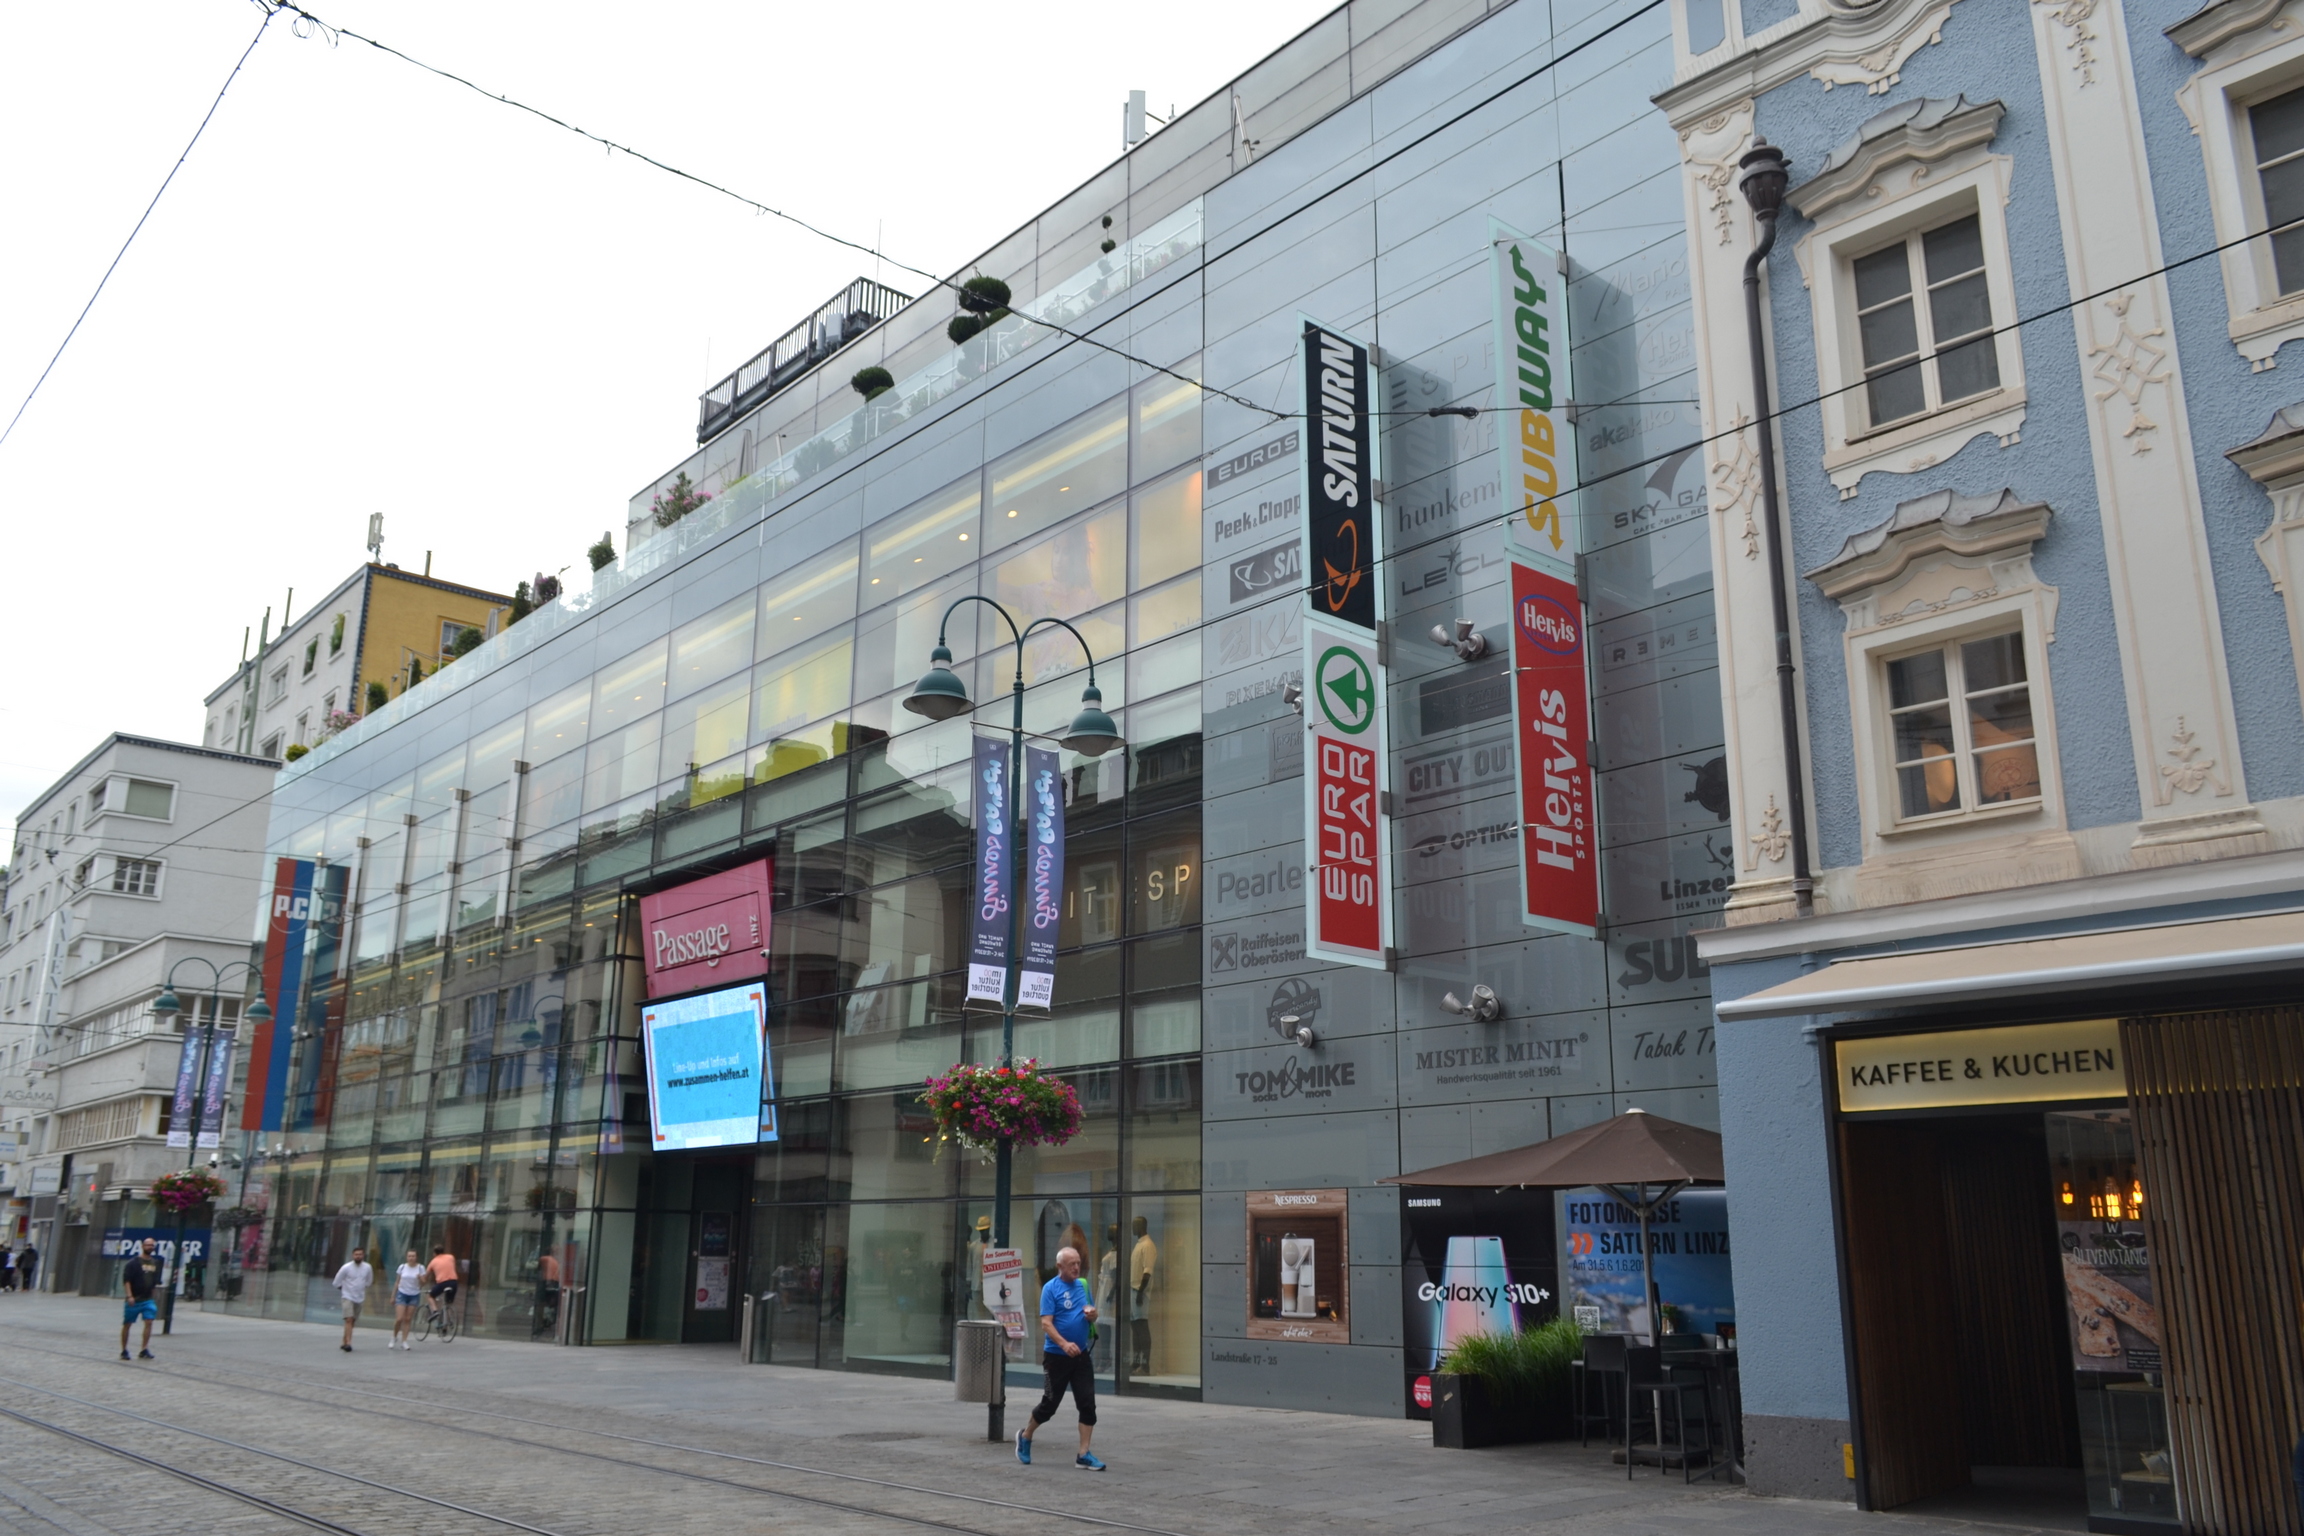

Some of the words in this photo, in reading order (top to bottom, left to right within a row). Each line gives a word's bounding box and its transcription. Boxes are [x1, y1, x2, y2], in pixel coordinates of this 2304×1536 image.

[1508, 244, 1564, 552] SUBWAY
[1320, 331, 1358, 508] SATURN
[1218, 433, 1297, 481] EUROS
[1399, 472, 1501, 532] hunkem
[1614, 500, 1661, 529] SKY
[1523, 602, 1576, 643] Hervis
[1408, 755, 1463, 793] CITY
[1533, 688, 1577, 872] Hervis
[1323, 744, 1347, 901] EURO
[1350, 751, 1373, 907] SPAR
[1572, 775, 1585, 860] SPORTS
[1217, 861, 1301, 904] Pearle
[749, 914, 760, 945] LINZ
[1241, 932, 1299, 951] Raiffeisen
[653, 923, 730, 968] Passage
[1416, 1046, 1500, 1070] MISTER
[1634, 1029, 1688, 1060] Tabak
[1518, 1068, 1535, 1079] seit
[1537, 1066, 1563, 1077] 1961
[1851, 1060, 1954, 1087] KAFFEE
[1963, 1058, 1983, 1079] &
[1993, 1048, 2115, 1078] KUCHEN
[1305, 1089, 1332, 1098] more
[1274, 1194, 1317, 1206] NESPRESSO
[1408, 1199, 1441, 1207] SAMSUNG
[1570, 1201, 1681, 1224] FOTOMSSE
[1684, 1232, 1729, 1254] LINZ
[1573, 1260, 1585, 1271] Am
[1418, 1282, 1498, 1308] Galaxy
[1503, 1283, 1550, 1304] S10+
[1253, 1356, 1261, 1365] 17
[1268, 1356, 1277, 1365] 25
